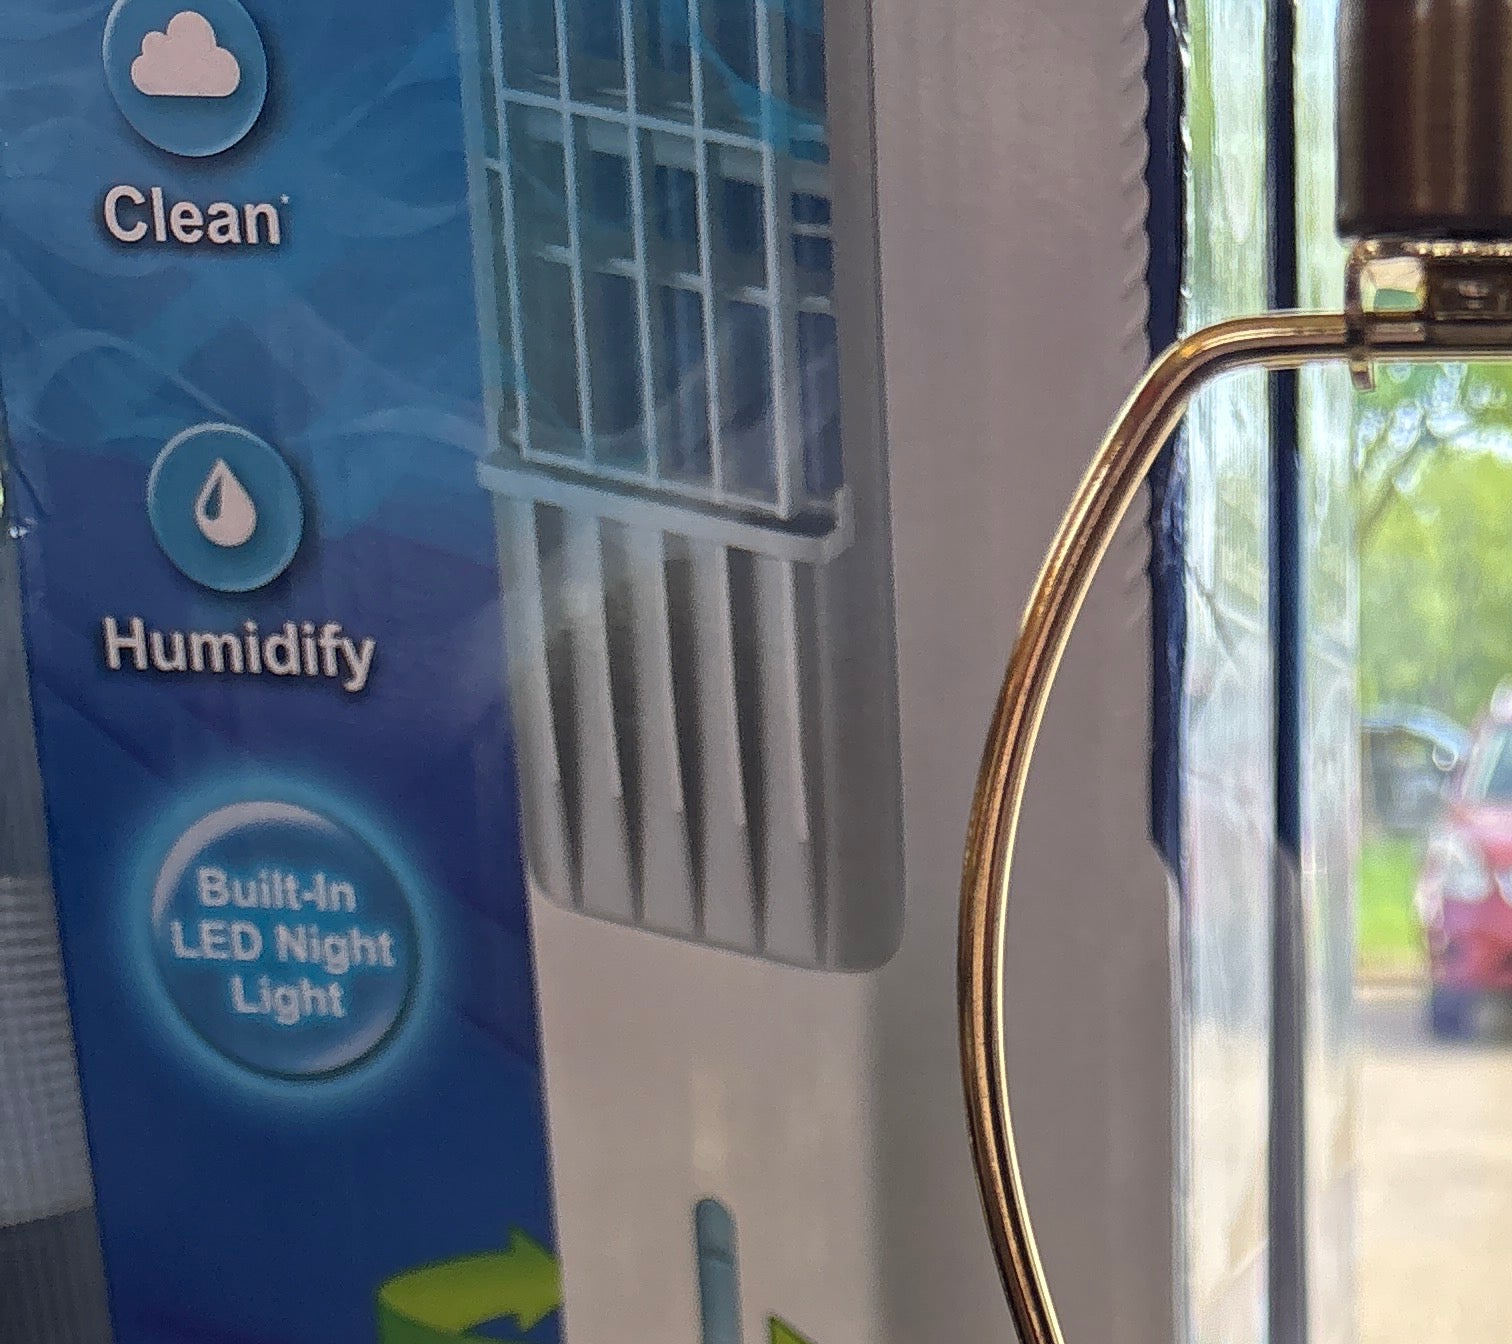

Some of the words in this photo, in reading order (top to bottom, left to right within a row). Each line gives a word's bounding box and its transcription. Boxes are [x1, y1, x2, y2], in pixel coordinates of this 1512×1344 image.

[103, 615, 377, 692] Humidify
[197, 866, 356, 912] Built-In
[170, 919, 263, 961] LED
[274, 923, 397, 975] Night
[229, 974, 347, 1025] Light
